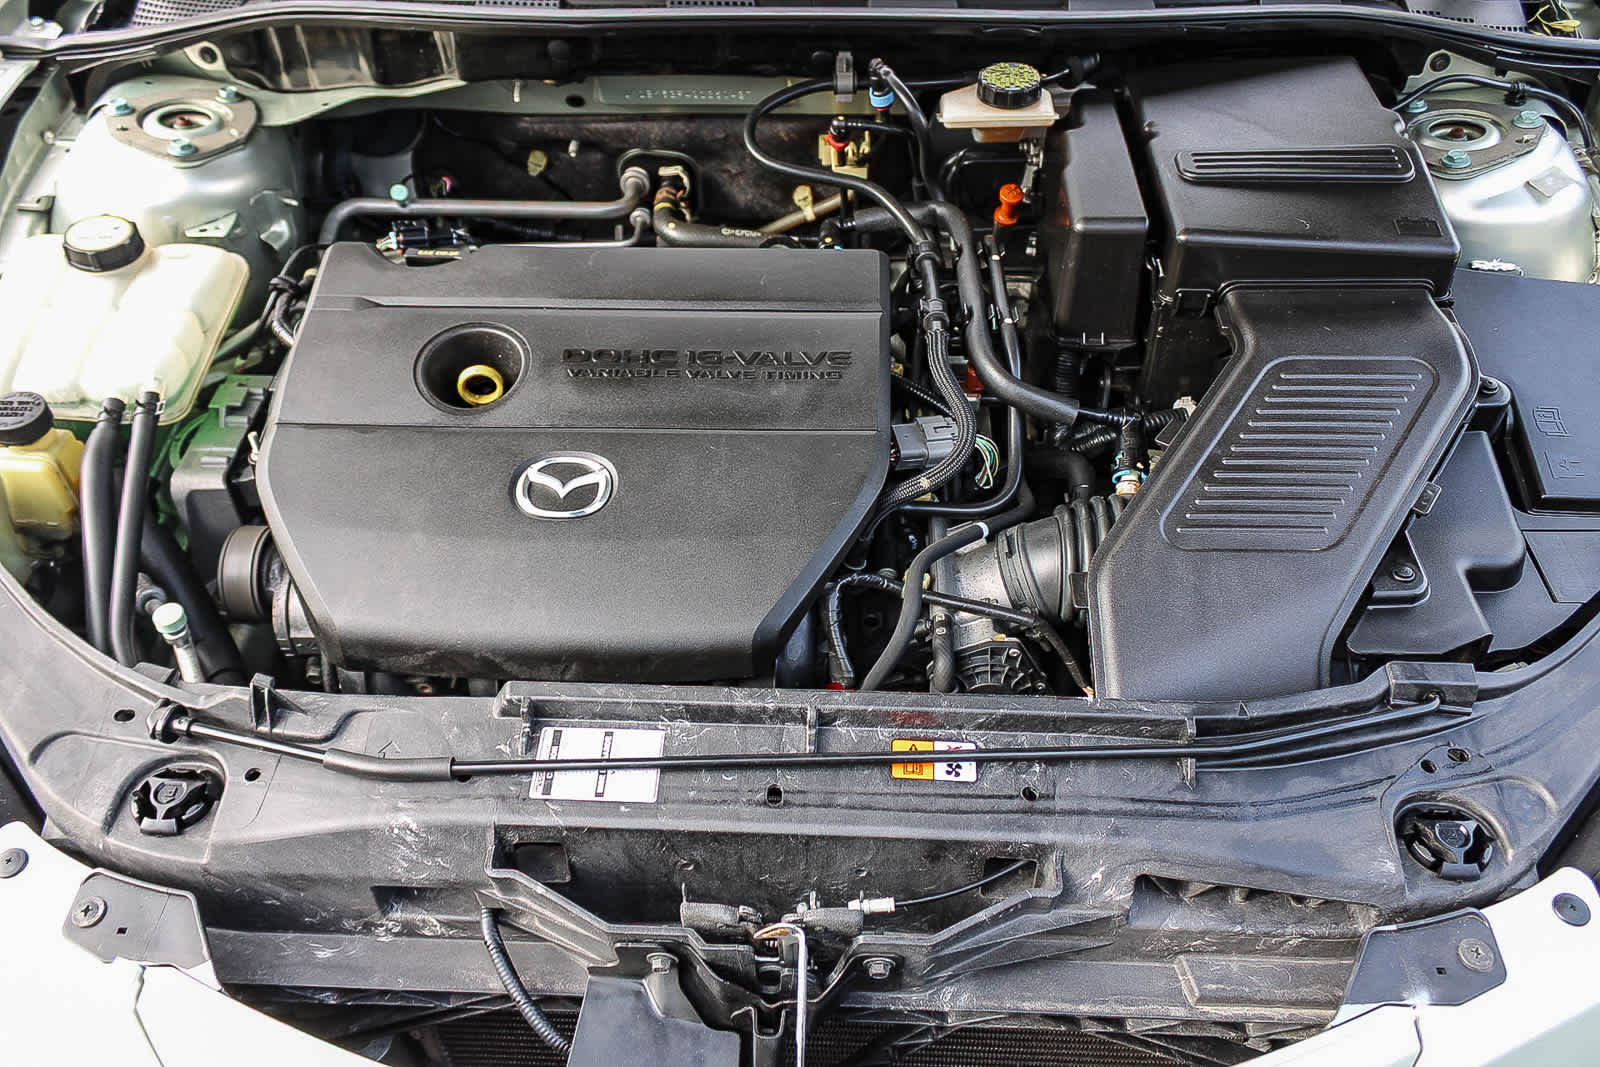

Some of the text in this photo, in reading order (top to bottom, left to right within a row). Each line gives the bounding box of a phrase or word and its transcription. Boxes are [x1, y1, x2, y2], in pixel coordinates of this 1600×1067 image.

[562, 348, 852, 367] DOHC 16-VALVE
[567, 367, 843, 380] VARIABLE VALVE TIMING
